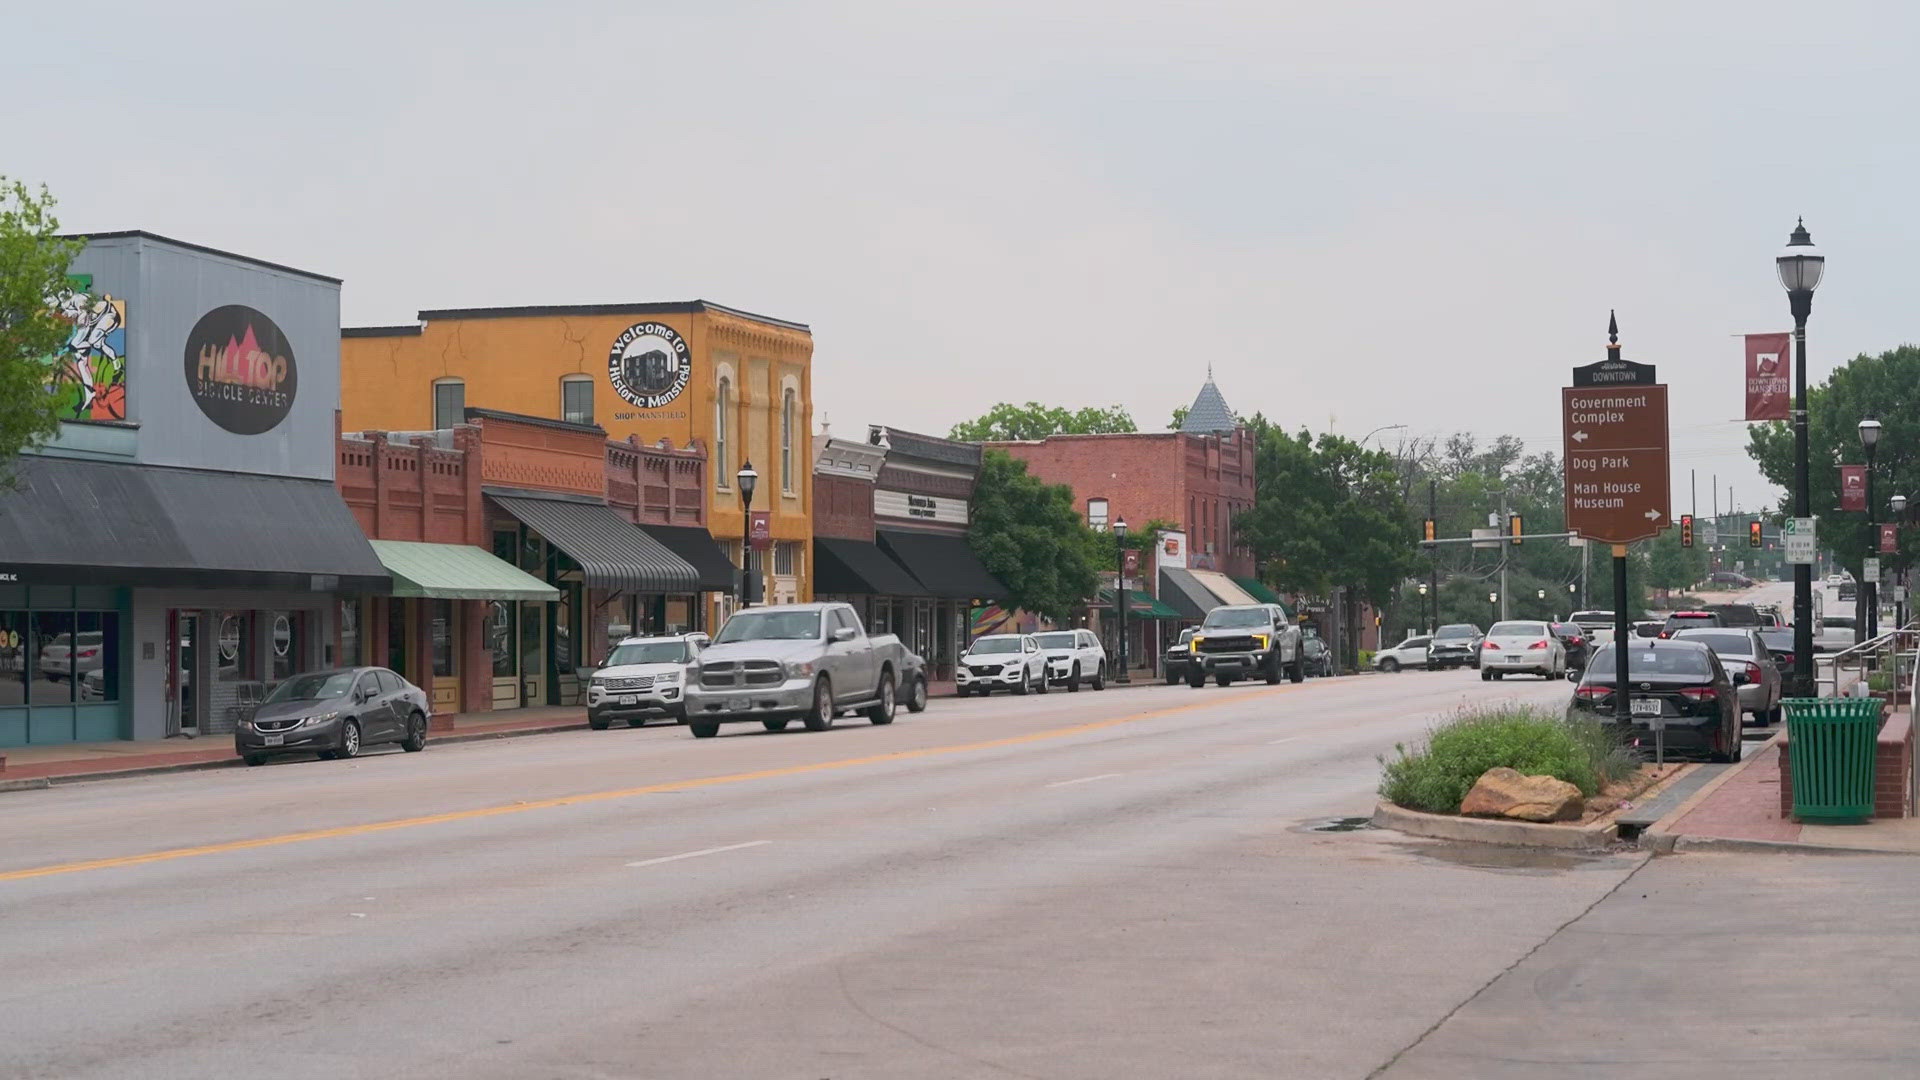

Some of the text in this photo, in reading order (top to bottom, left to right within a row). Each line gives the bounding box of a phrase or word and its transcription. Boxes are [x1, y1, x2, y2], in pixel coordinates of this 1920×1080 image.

[611, 323, 686, 355] Welcome to
[1592, 371, 1637, 382] DOWNTOWN
[609, 364, 691, 409] Historic Mansfield
[1748, 385, 1788, 394] MANSFIELD
[1571, 396, 1647, 409] Government
[614, 411, 687, 421] SHOP MANSFIELD
[1571, 411, 1625, 425] Complex
[1573, 456, 1630, 471] Dog Park
[1574, 482, 1641, 494] Man House
[1574, 497, 1624, 509] Museum
[1787, 521, 1795, 534] 2
